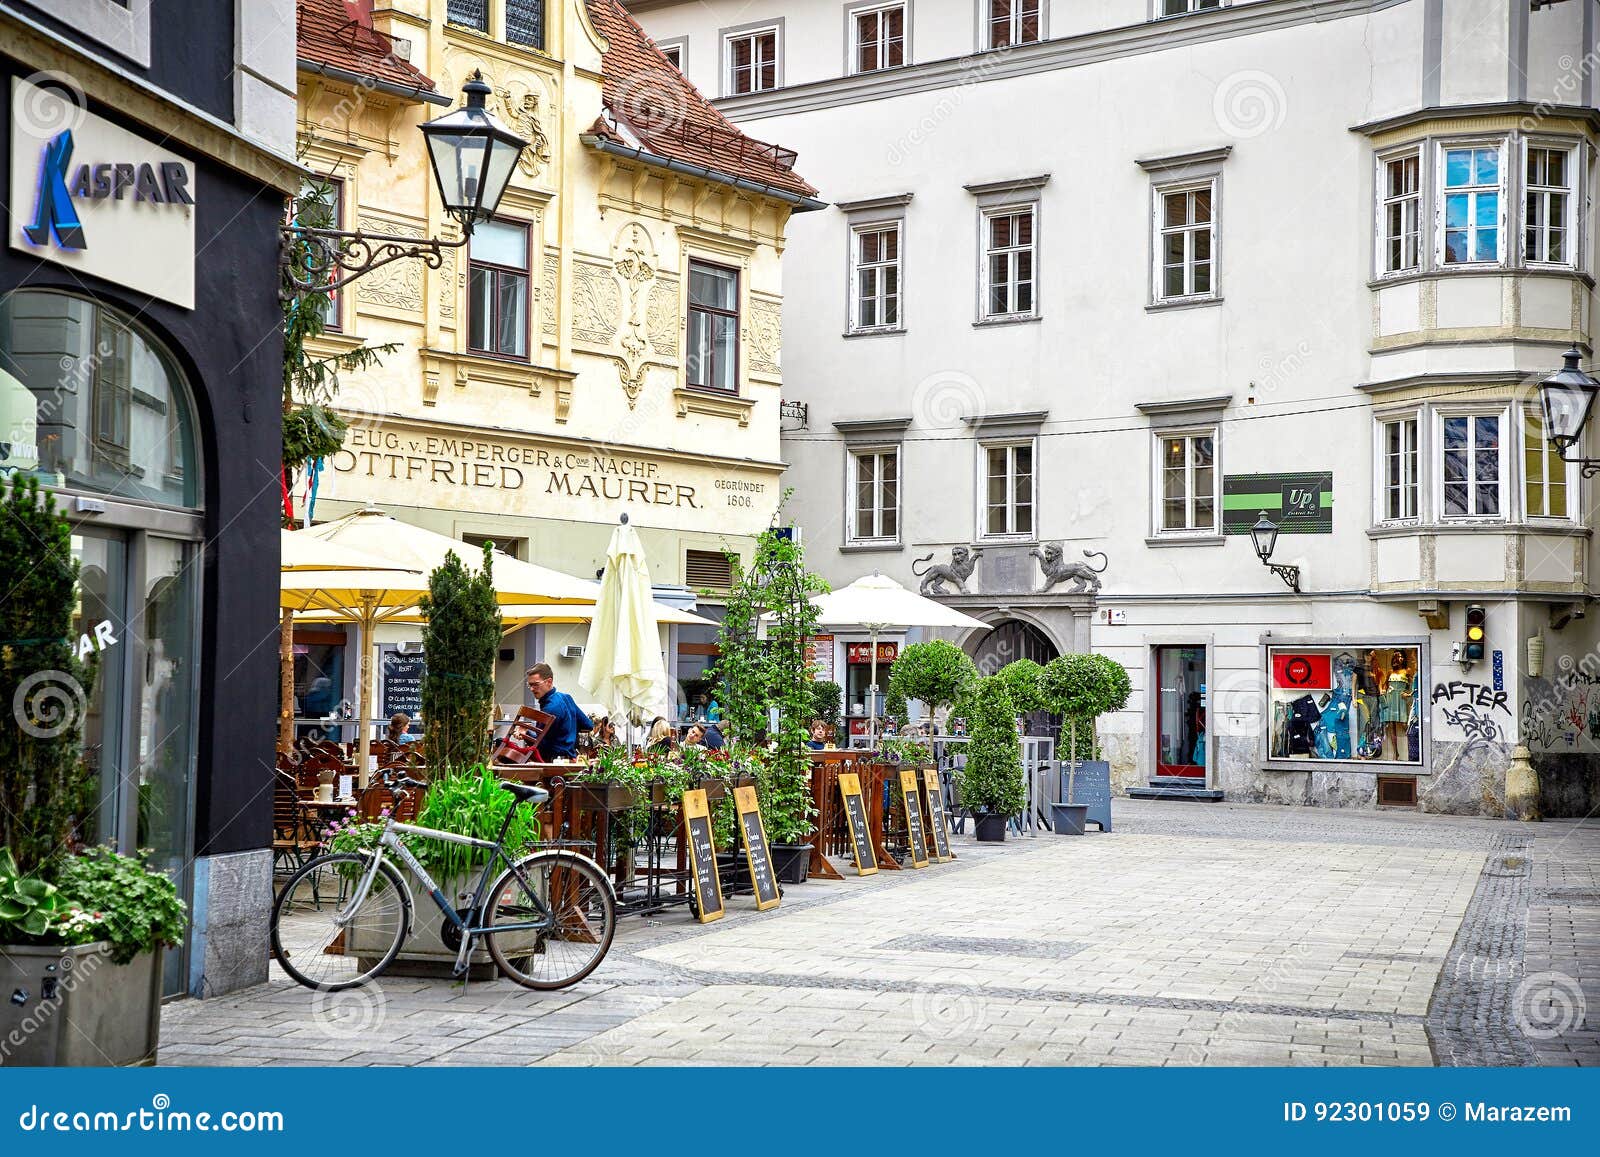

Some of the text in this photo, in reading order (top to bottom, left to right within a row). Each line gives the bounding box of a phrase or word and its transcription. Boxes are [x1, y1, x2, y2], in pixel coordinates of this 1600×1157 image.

[23, 127, 196, 250] KASPAR
[426, 437, 550, 467] EMPERGER
[334, 449, 704, 509] OTTFRIED MAURER.
[714, 479, 765, 494] GEGRÜNDET
[1289, 489, 1313, 509] Up
[1432, 681, 1513, 717] AFTER
